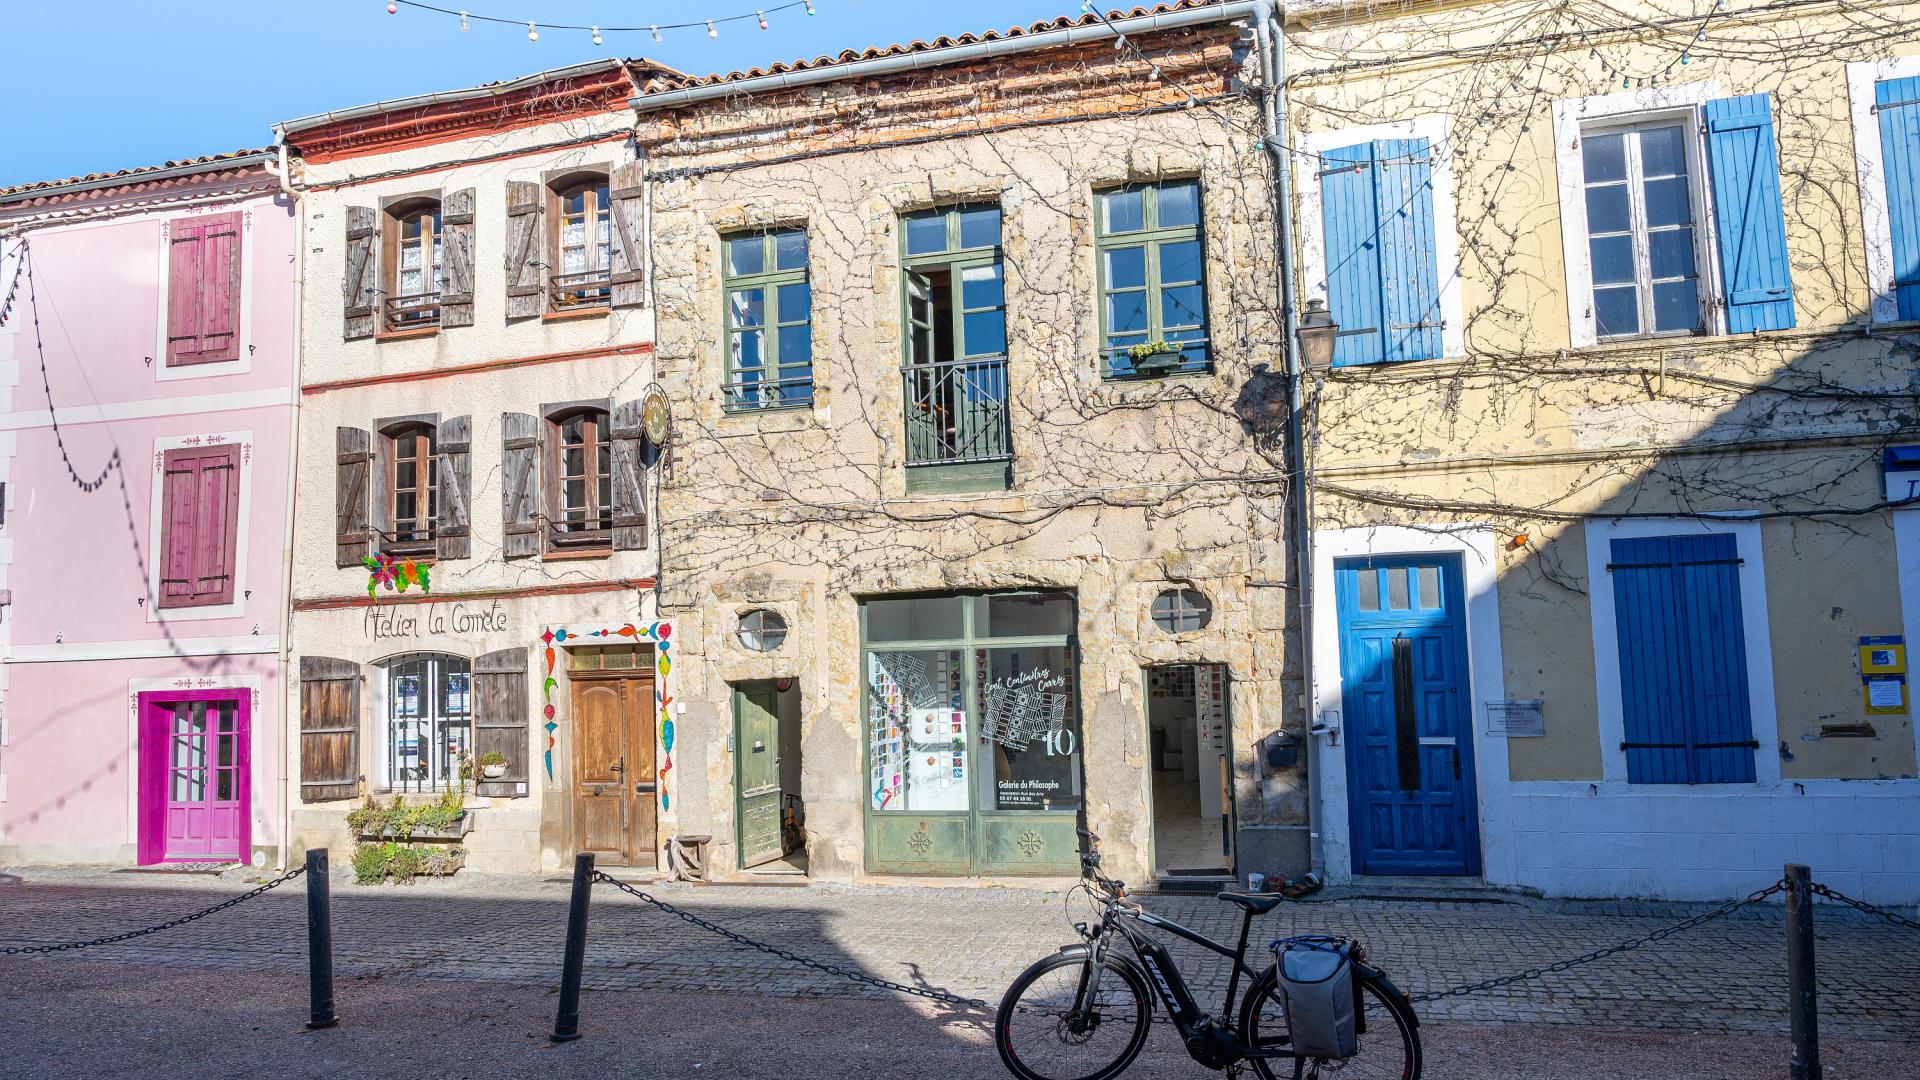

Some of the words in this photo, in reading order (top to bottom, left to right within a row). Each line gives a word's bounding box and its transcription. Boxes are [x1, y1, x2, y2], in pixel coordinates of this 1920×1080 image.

[364, 604, 419, 642] Atelier
[984, 677, 1003, 694] Cent
[999, 780, 1019, 789] Galerie
[1020, 780, 1028, 789] du
[1029, 780, 1059, 791] Philosophe
[1144, 955, 1182, 1014] GIANT
